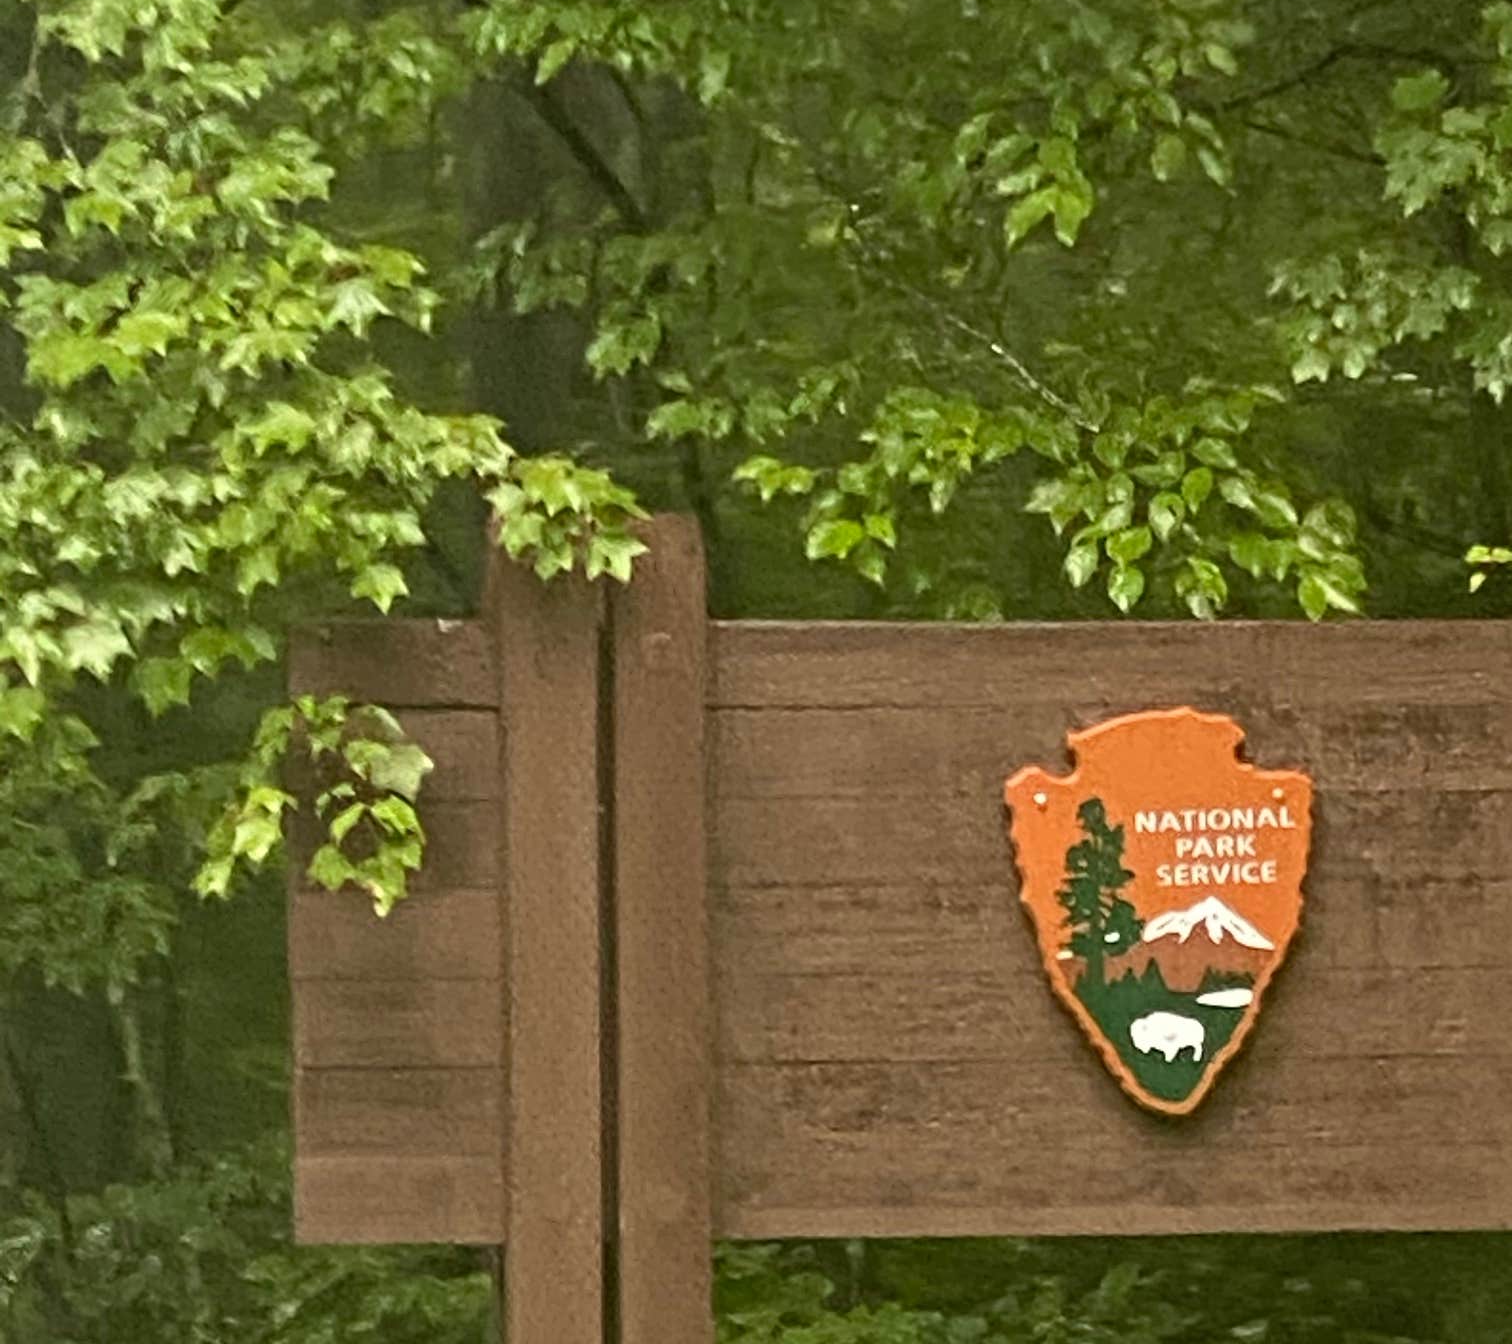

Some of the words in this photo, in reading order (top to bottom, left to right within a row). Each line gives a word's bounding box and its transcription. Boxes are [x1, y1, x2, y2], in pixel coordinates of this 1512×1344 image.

[1134, 805, 1296, 834] NATIONAL
[1175, 834, 1257, 859] PARK
[1155, 860, 1277, 887] SERVICE
